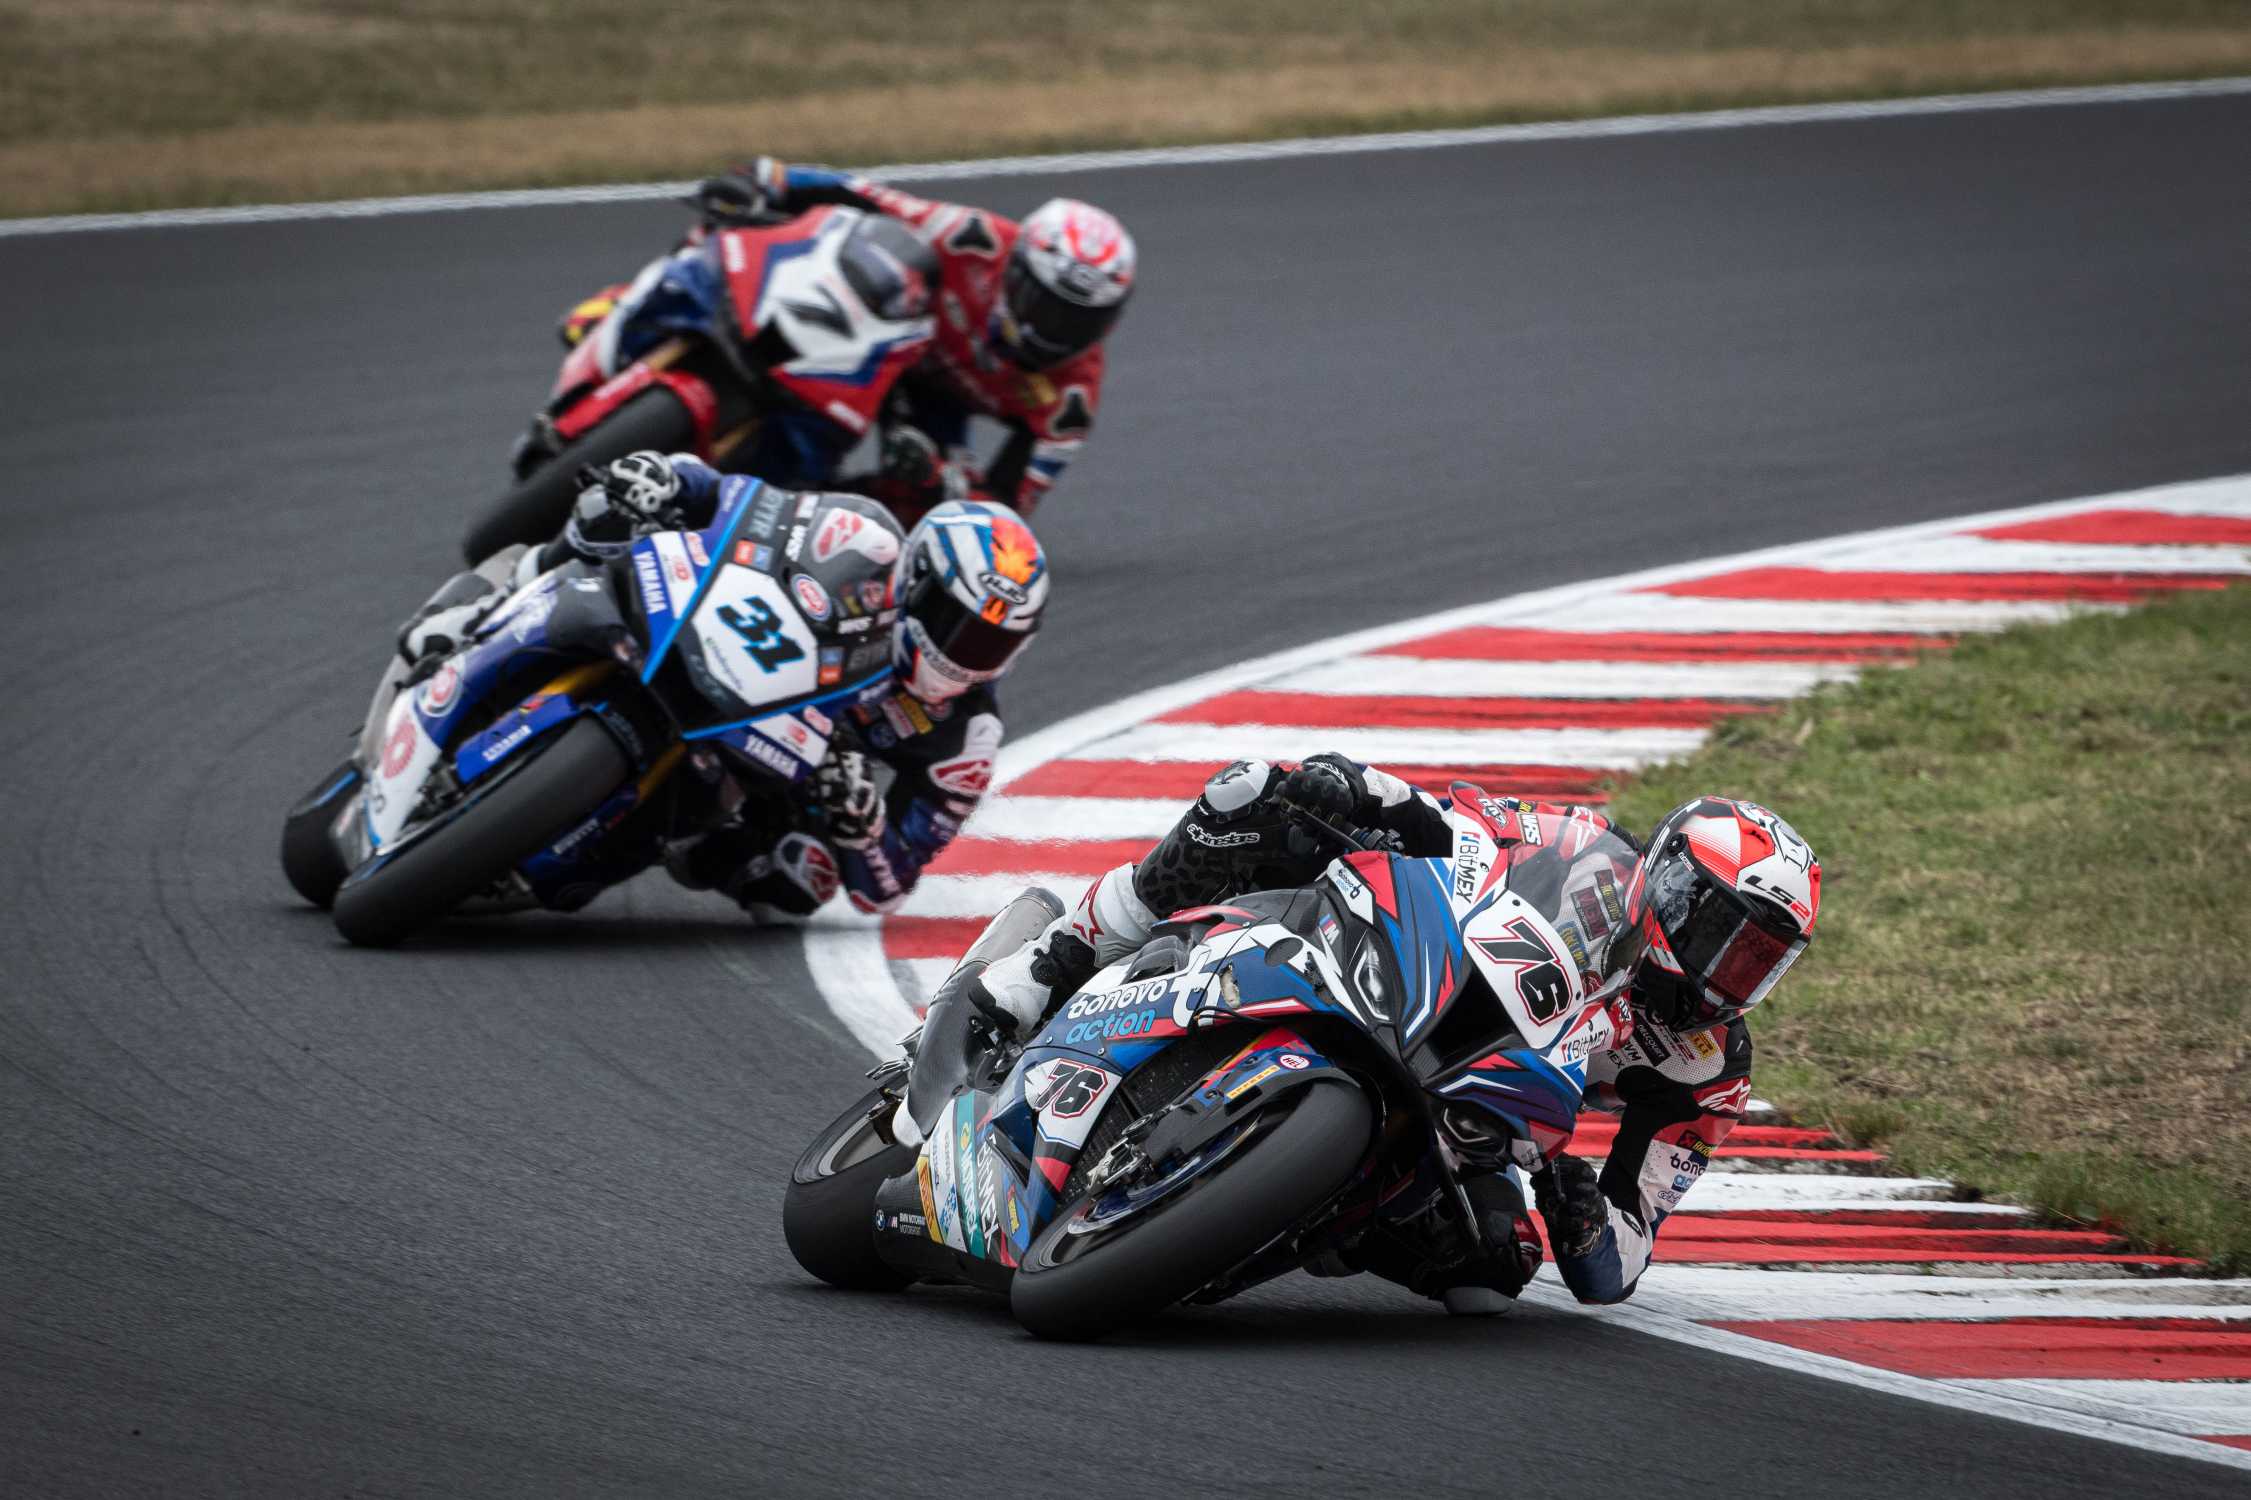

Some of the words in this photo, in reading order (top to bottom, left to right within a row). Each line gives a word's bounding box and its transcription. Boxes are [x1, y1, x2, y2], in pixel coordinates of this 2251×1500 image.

[634, 550, 667, 614] YAMAHA
[716, 596, 806, 674] 31
[744, 734, 799, 780] YAMAHA
[1186, 823, 1261, 848] alpinestars
[1520, 813, 1543, 846] WRS
[1456, 844, 1480, 904] BitMEX
[1745, 874, 1811, 921] LS2
[1467, 916, 1574, 1027] 76
[1067, 979, 1168, 1019] bonovo
[1065, 1009, 1157, 1045] action
[1572, 1026, 1610, 1059] BitMEX
[1034, 1057, 1109, 1119] 76
